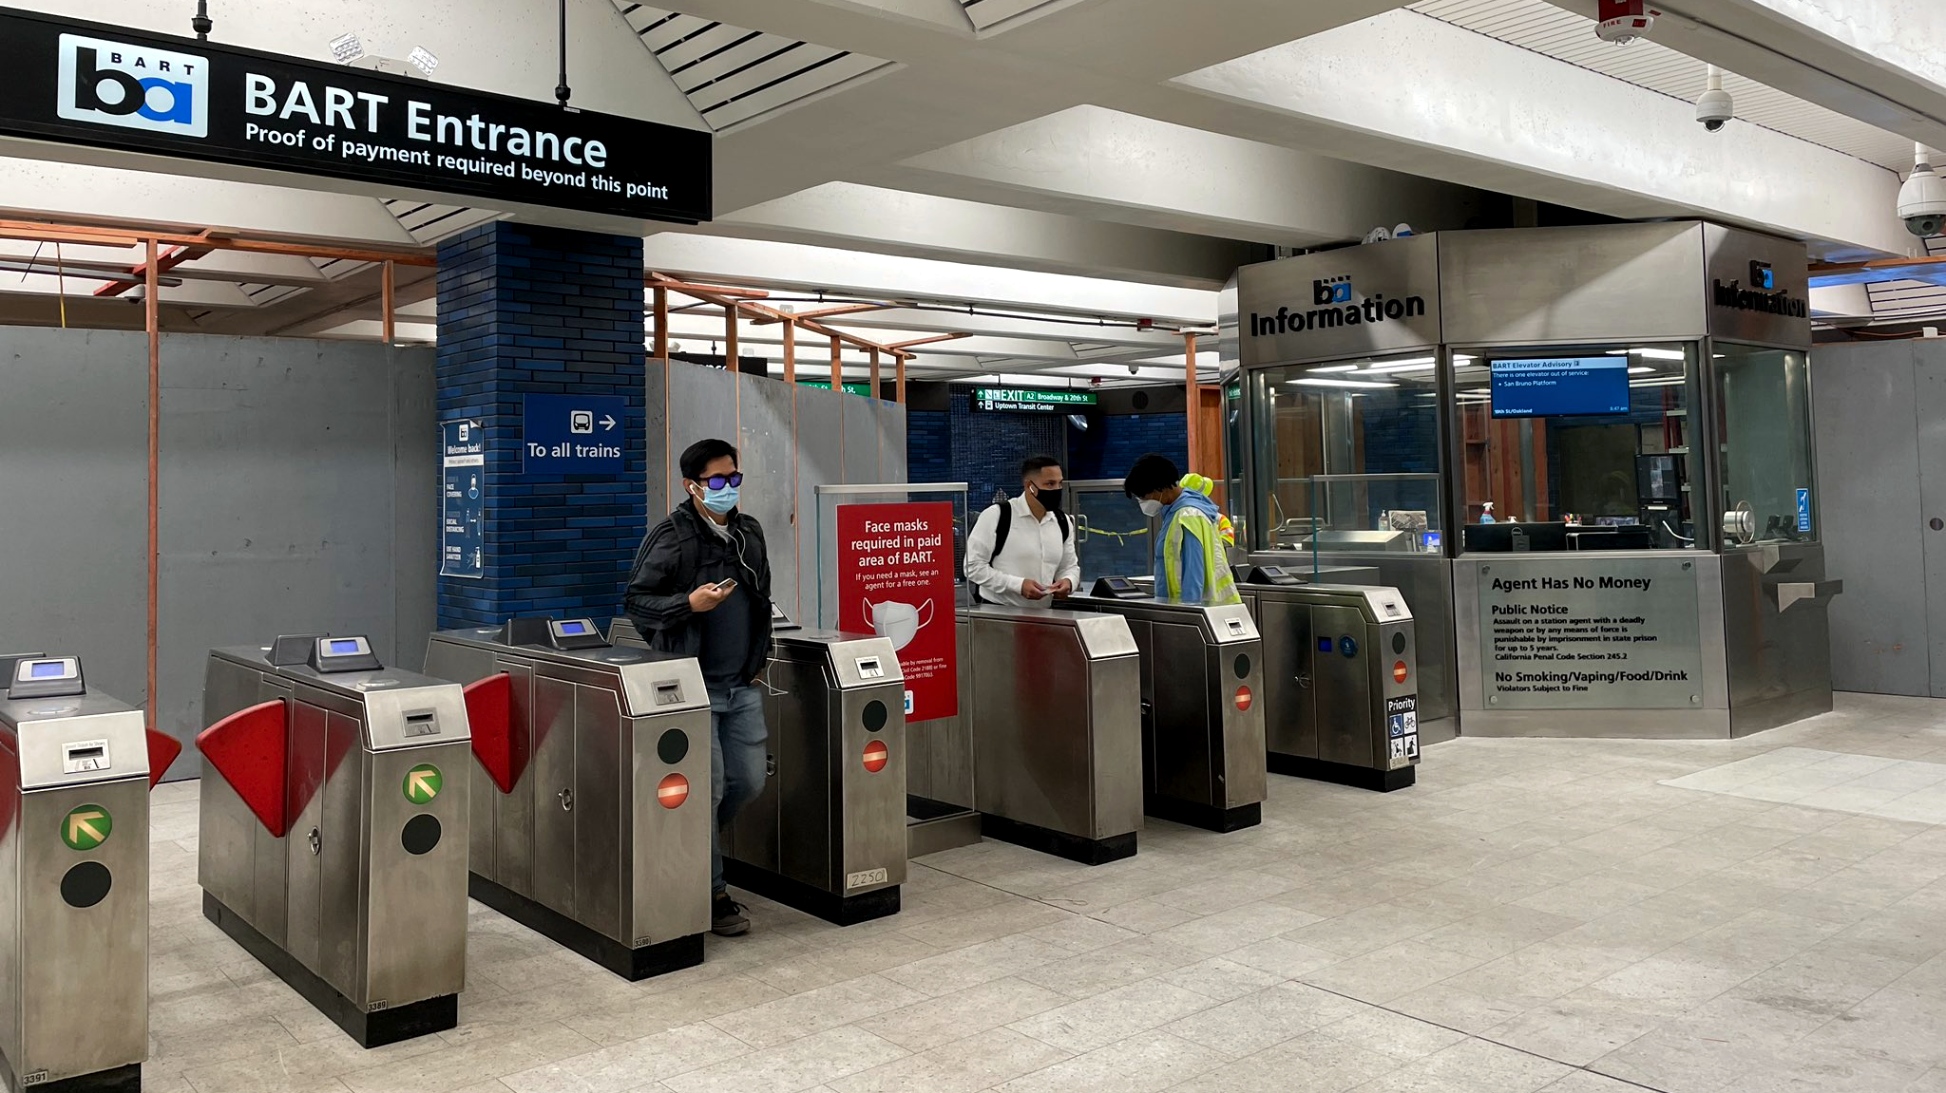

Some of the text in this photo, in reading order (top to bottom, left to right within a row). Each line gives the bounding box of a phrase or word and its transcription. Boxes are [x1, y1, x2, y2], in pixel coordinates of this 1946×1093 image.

[1602, 20, 1621, 28] FIRE
[111, 52, 194, 76] BART
[246, 72, 606, 168] BART Entrance
[246, 122, 668, 199] Proof of payment required beyond this point
[1713, 279, 1806, 318] Information
[1250, 294, 1424, 336] Information
[1542, 360, 1572, 369] Advisory
[1001, 390, 1024, 400] EXIT
[1037, 394, 1063, 402] Broadway
[995, 402, 1018, 410] Uptown
[527, 442, 621, 458] To all trains
[865, 518, 928, 532] Face masks
[851, 533, 942, 552] required in paid
[858, 551, 936, 567] area of BART.
[862, 574, 874, 582] you
[876, 570, 893, 580] need
[900, 570, 918, 578] mask,
[930, 568, 939, 576] an
[864, 582, 884, 592] agent
[886, 580, 896, 588] for
[902, 579, 916, 587] free
[916, 578, 931, 586] one.
[1492, 576, 1652, 592] Agent Has No Money
[1491, 604, 1568, 615] Public Notice
[1569, 618, 1591, 626] agent
[1619, 616, 1646, 625] deadly
[1536, 626, 1546, 634] by
[1494, 636, 1536, 644] punishable
[1537, 636, 1546, 644] by
[1548, 634, 1601, 643] imprisonment
[1603, 634, 1610, 642] in
[1633, 634, 1658, 643] prison
[1494, 644, 1506, 652] for
[1577, 652, 1605, 660] Section
[1606, 652, 1628, 660] 245.2
[1496, 670, 1688, 684] No Smoking/Vaping/Food/Drink
[1496, 684, 1531, 692] Violators
[1532, 684, 1560, 693] Subject
[1572, 684, 1588, 692] Fine
[1388, 698, 1416, 712] Priority
[24, 1073, 46, 1085] 3391
